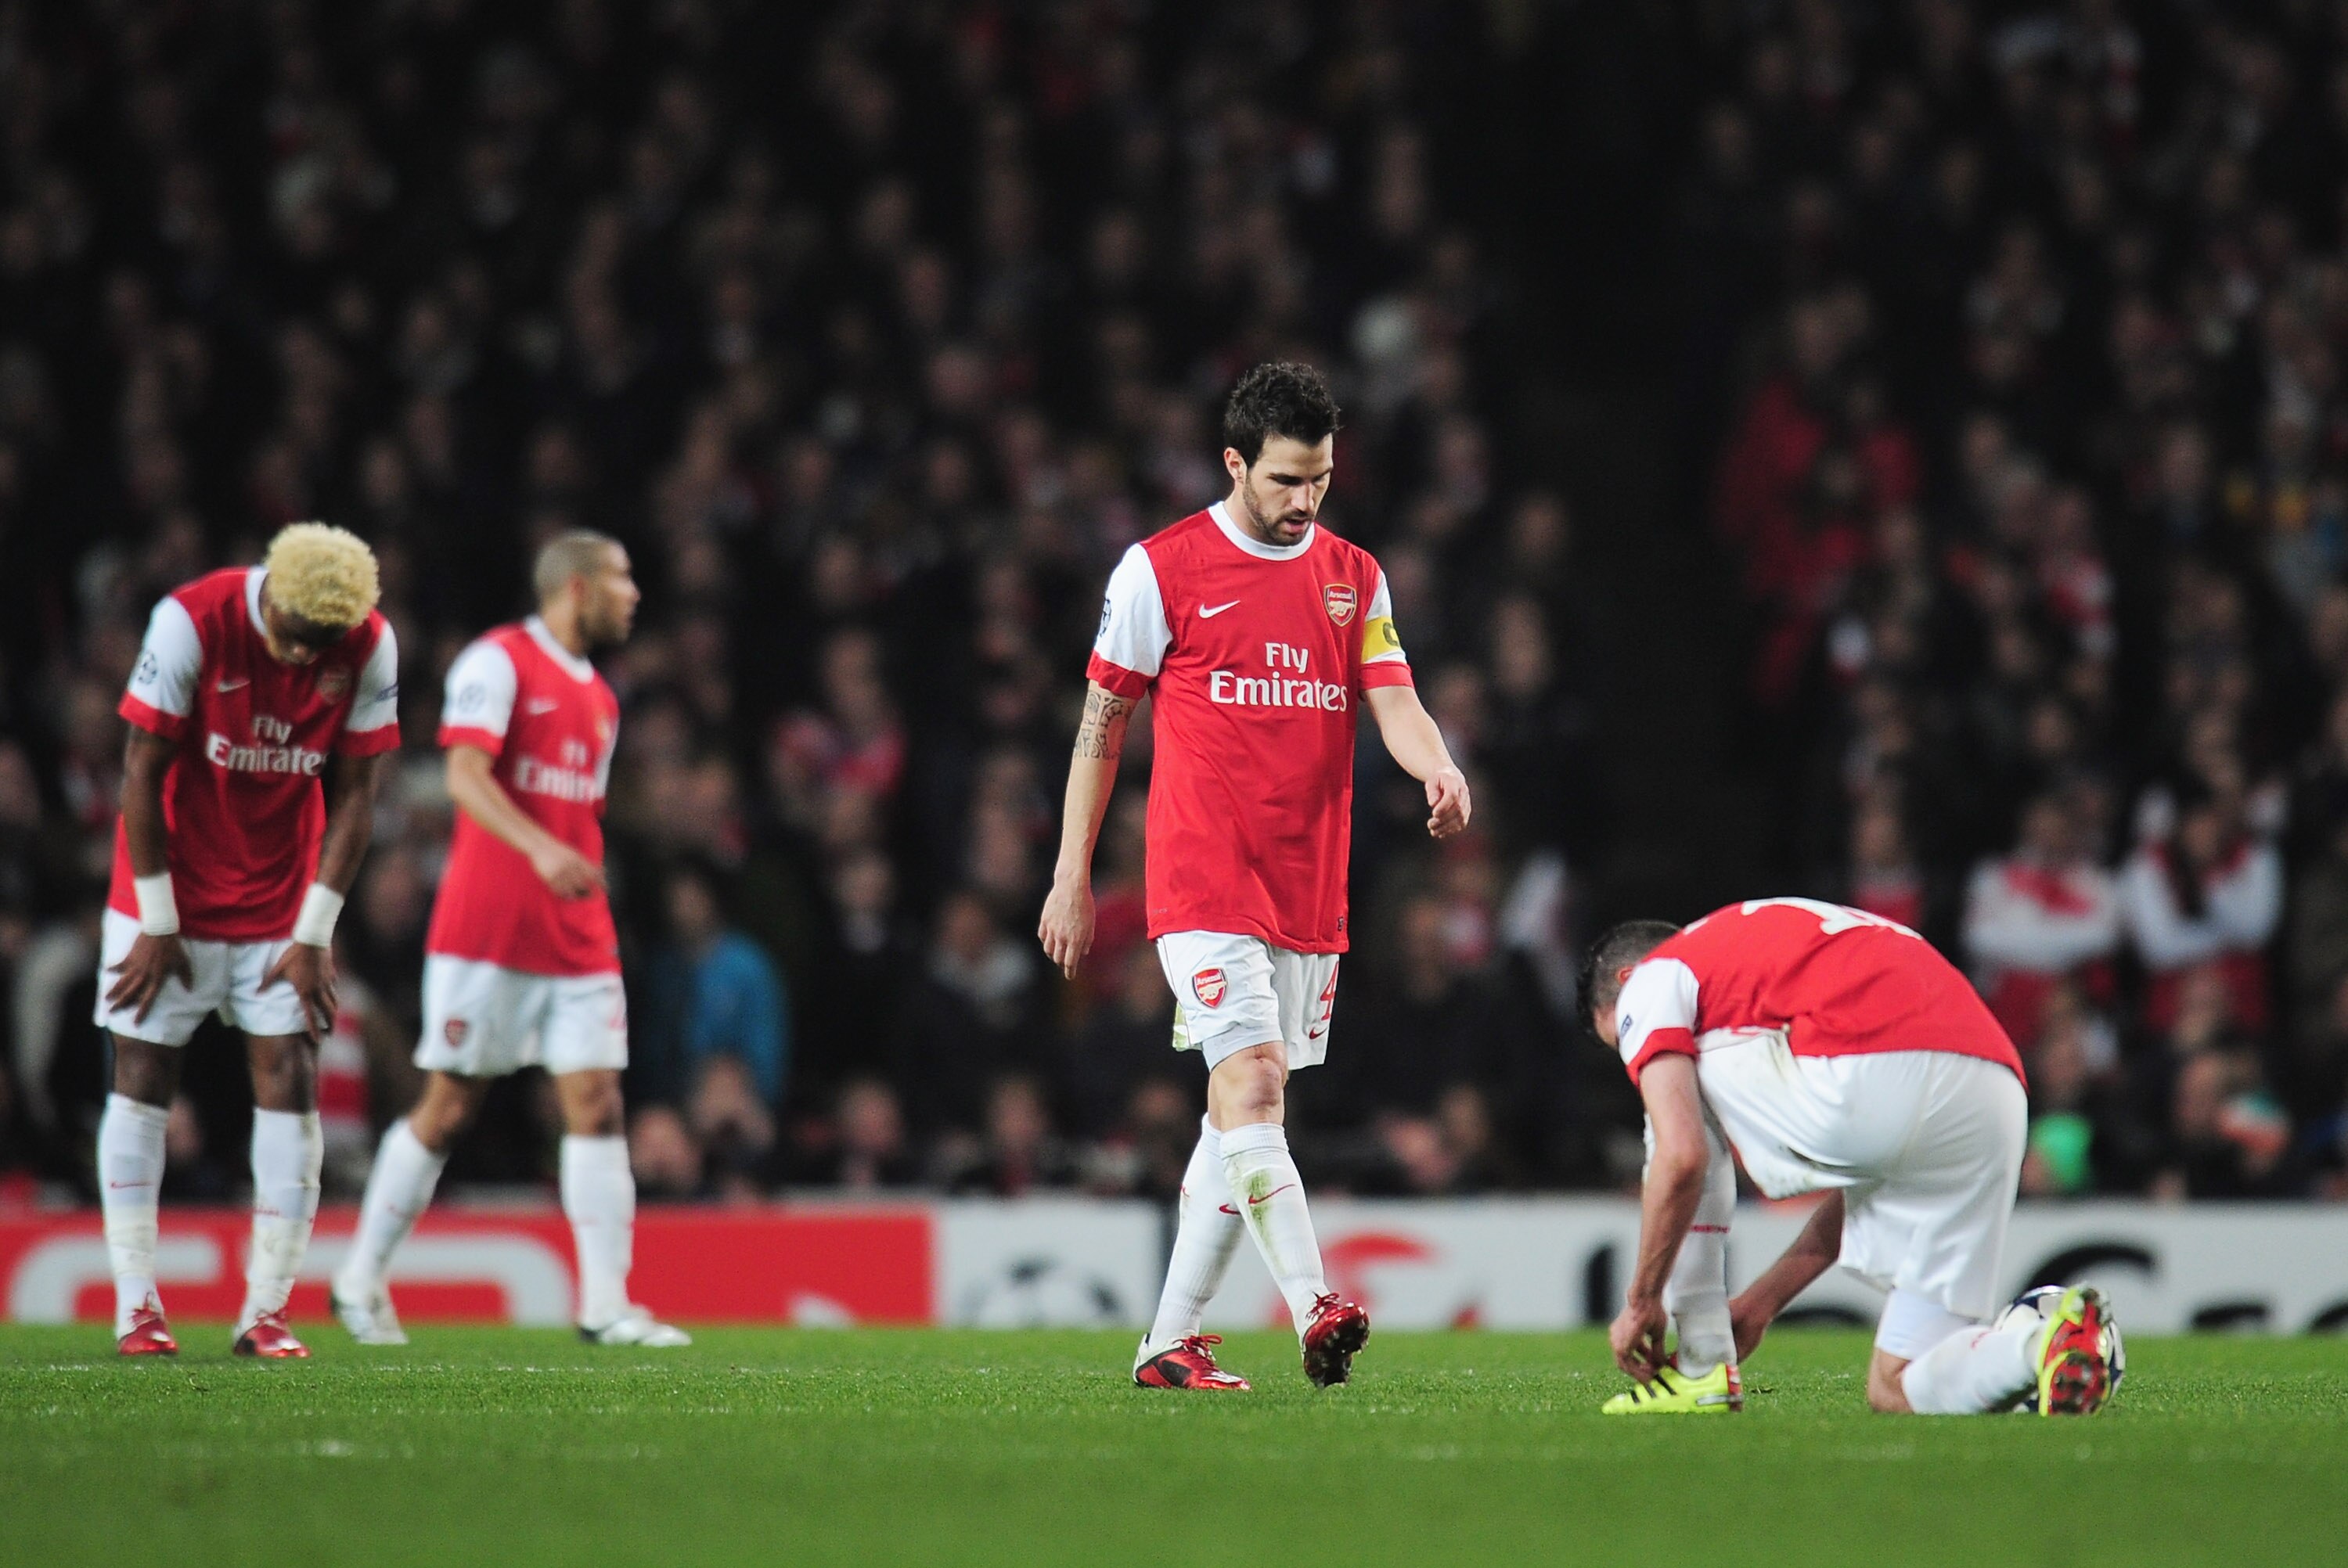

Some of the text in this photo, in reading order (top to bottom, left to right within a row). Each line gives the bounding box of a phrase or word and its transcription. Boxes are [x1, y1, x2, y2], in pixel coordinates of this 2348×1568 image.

[1265, 642, 1309, 674] Fly
[1210, 671, 1348, 712] Emirates
[207, 731, 327, 775] Emirate
[1320, 960, 1340, 1021] 4
